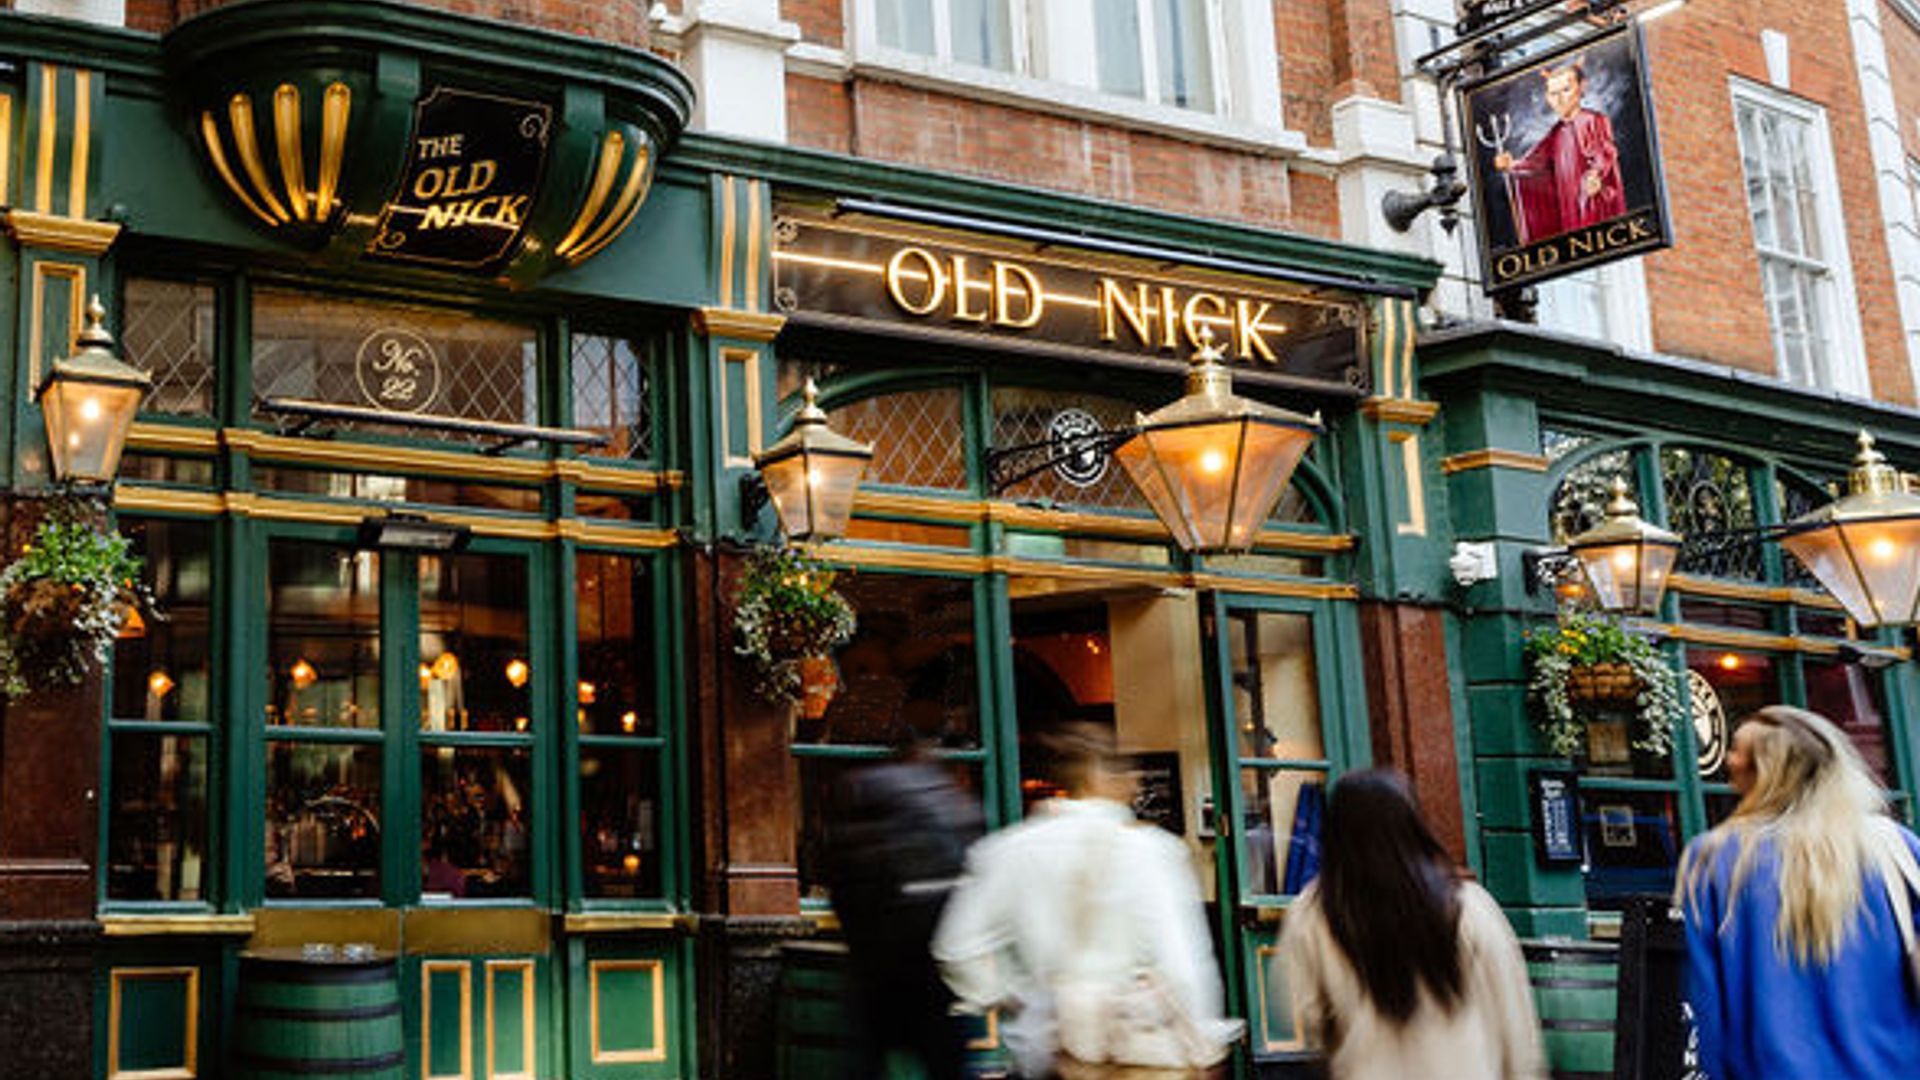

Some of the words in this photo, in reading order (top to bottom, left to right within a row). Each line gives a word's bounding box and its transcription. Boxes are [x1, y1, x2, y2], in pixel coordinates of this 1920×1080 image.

[416, 133, 465, 159] THE
[413, 159, 498, 199] OLD
[417, 194, 528, 230] NICK
[1497, 245, 1560, 278] OLD
[1569, 217, 1650, 258] NICK
[885, 246, 1044, 329] OLD
[1097, 277, 1278, 363] NICK
[380, 376, 417, 401] 22
